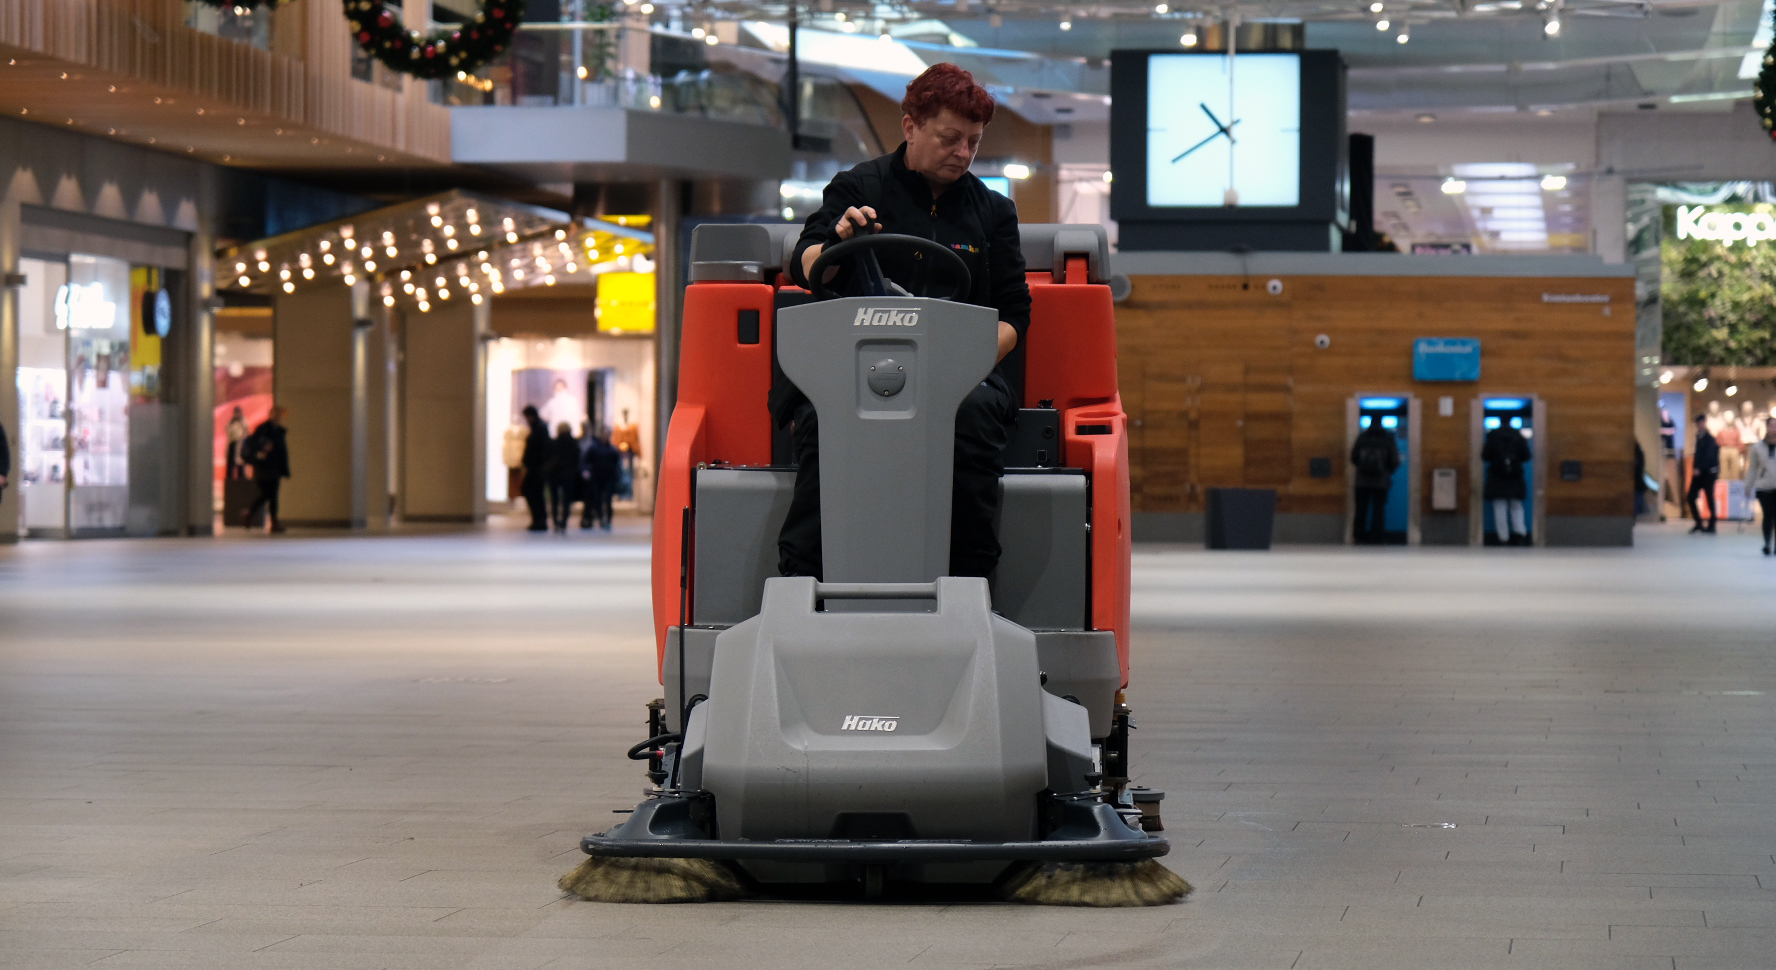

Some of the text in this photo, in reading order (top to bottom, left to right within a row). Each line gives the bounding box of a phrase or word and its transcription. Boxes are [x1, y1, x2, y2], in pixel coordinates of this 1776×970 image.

[1676, 205, 1776, 247] Kapp
[853, 308, 921, 326] Hako
[841, 715, 900, 732] Hako
